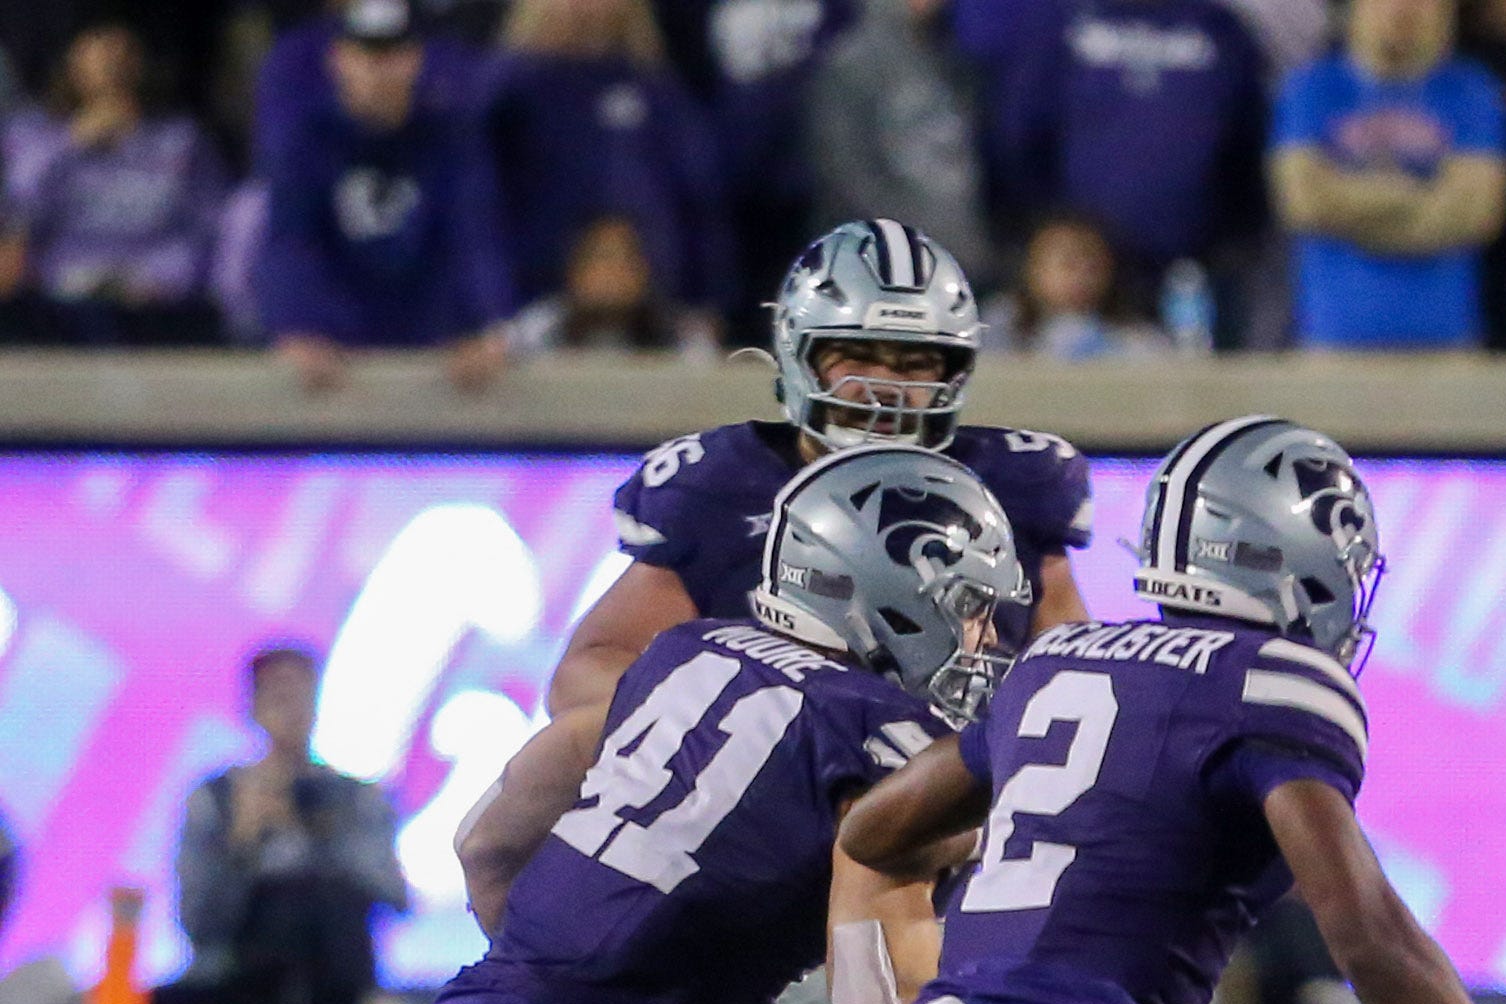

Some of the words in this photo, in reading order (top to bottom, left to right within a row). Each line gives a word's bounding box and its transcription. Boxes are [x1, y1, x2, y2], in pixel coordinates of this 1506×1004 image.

[780, 562, 808, 588] XII
[702, 624, 849, 684] MOORE
[551, 650, 805, 895] 41
[960, 669, 1120, 913] 2
